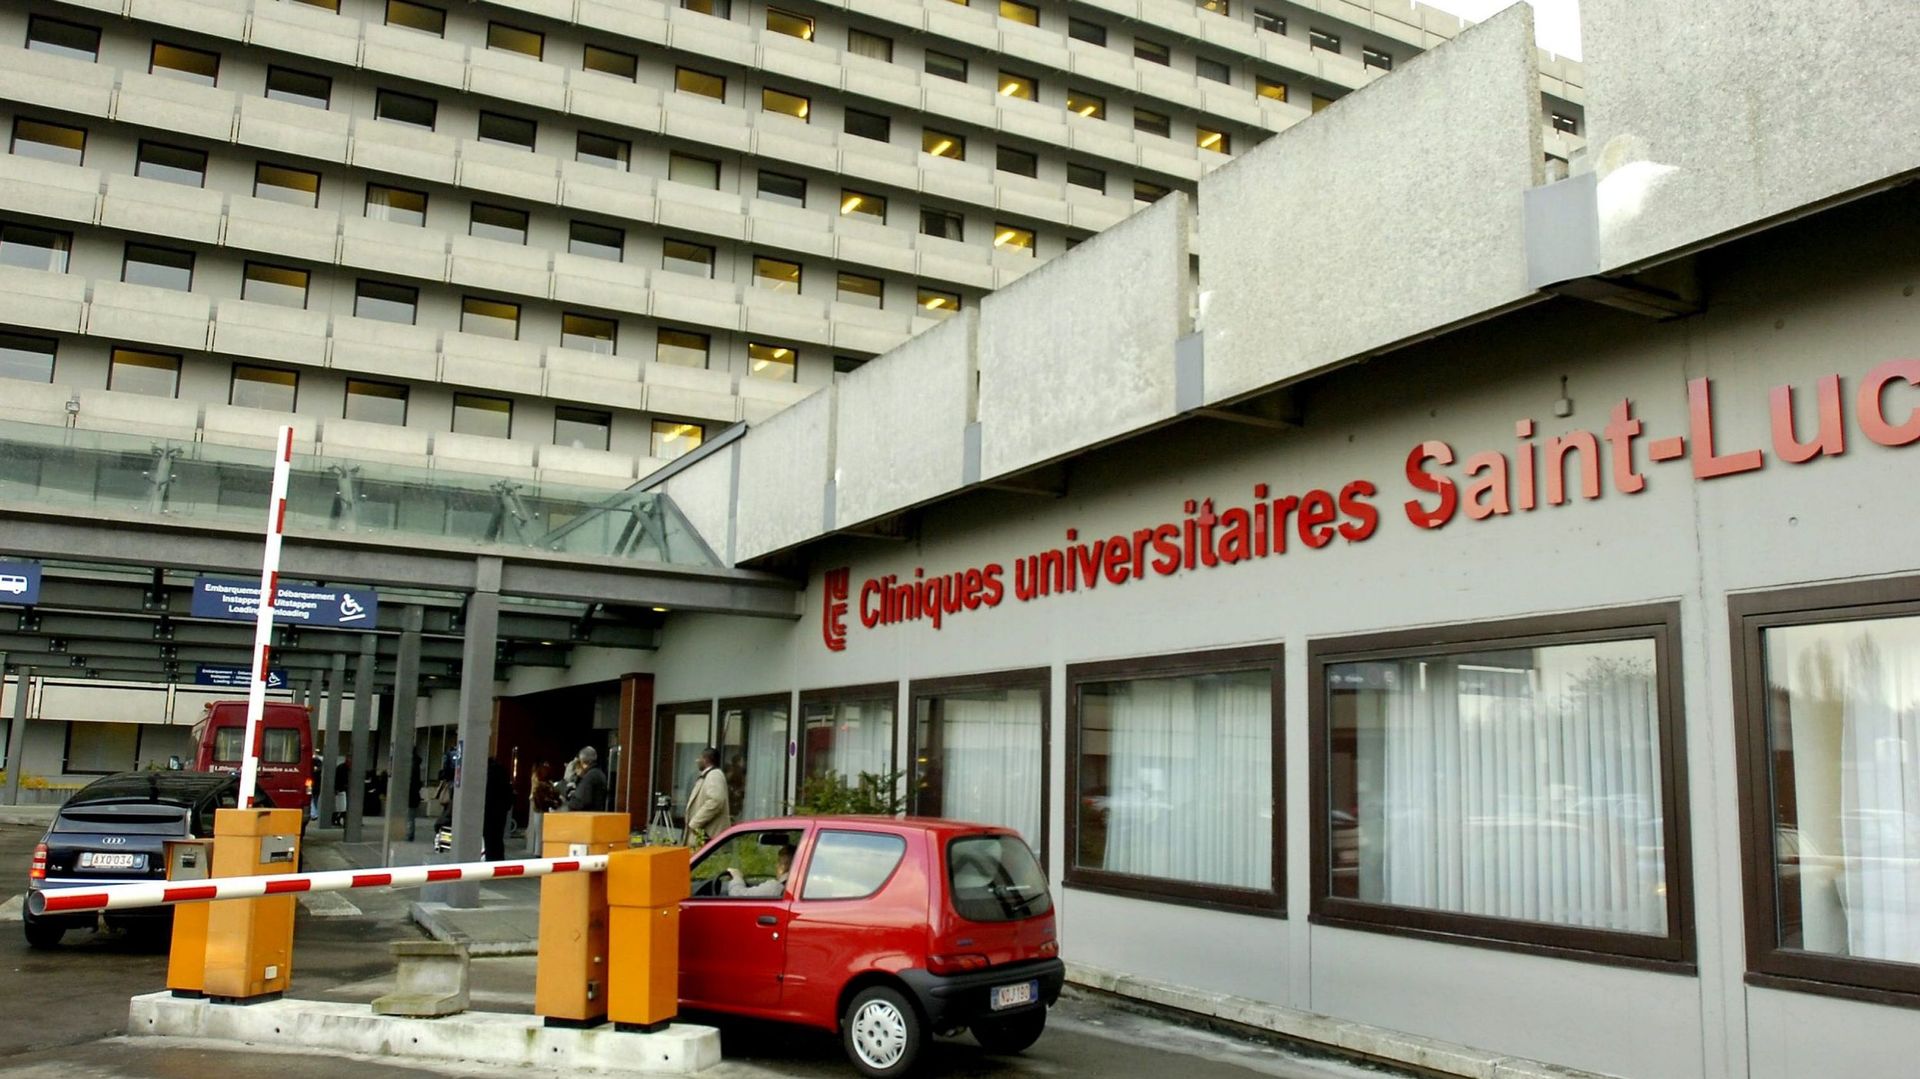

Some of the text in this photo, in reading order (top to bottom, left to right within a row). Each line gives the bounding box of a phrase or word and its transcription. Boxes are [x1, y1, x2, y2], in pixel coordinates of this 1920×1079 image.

[858, 359, 1920, 629] Cliniques universitaires Saint-Luc
